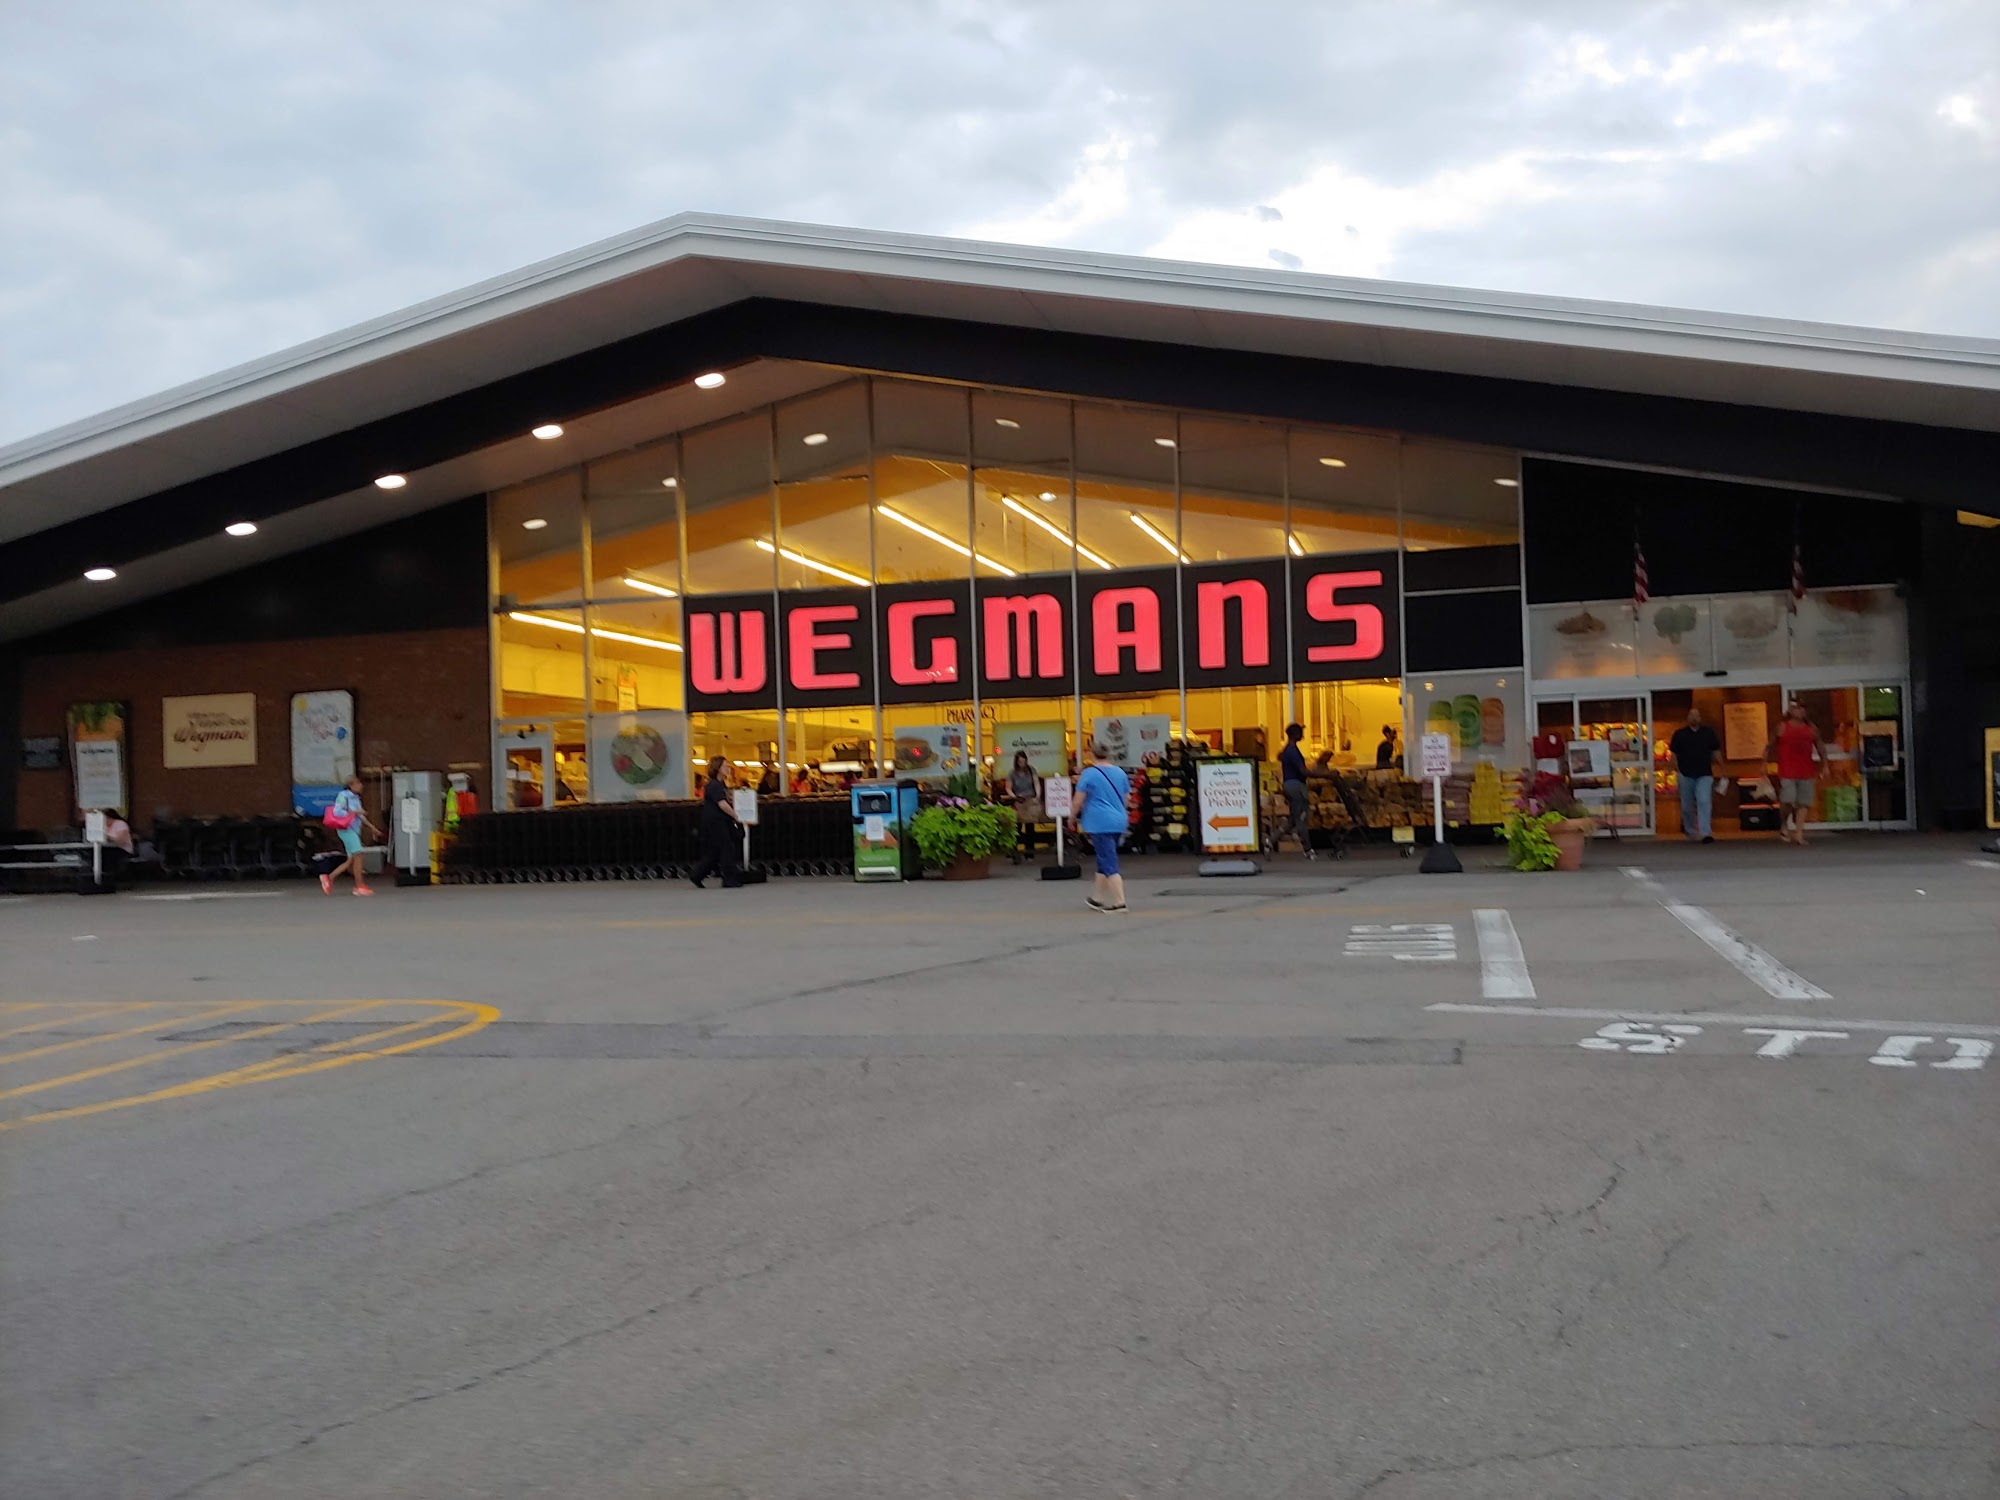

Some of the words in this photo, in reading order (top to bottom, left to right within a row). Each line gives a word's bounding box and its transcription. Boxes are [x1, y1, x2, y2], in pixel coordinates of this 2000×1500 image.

[689, 569, 1385, 694] WEGMANS
[1204, 787, 1247, 797] Grocery
[1208, 796, 1246, 808] Pickup
